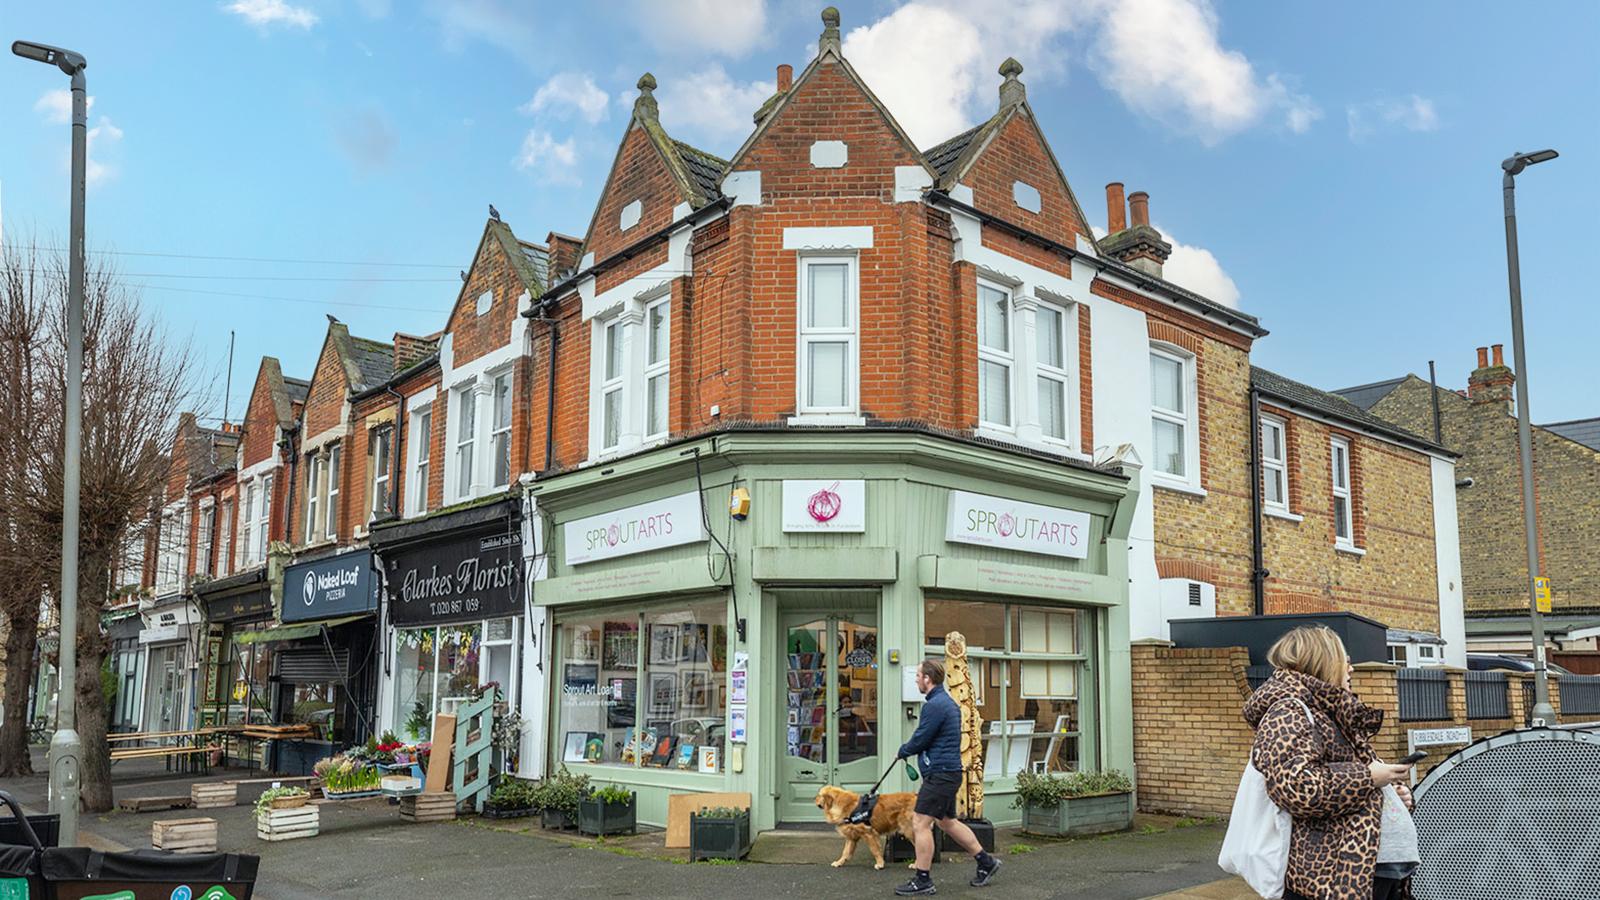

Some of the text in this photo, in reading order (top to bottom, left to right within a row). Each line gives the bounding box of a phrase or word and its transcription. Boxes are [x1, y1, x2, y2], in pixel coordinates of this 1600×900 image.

[586, 512, 673, 551] SPROUTARTS
[967, 508, 1078, 547] SPROUTARTS
[317, 565, 360, 591] Naked Loaf
[402, 557, 515, 603] Clarkes Florist
[325, 588, 346, 601] PIZZERIA
[563, 683, 585, 698] Sprout
[585, 683, 596, 696] Art
[1446, 730, 1459, 741] ROAD
